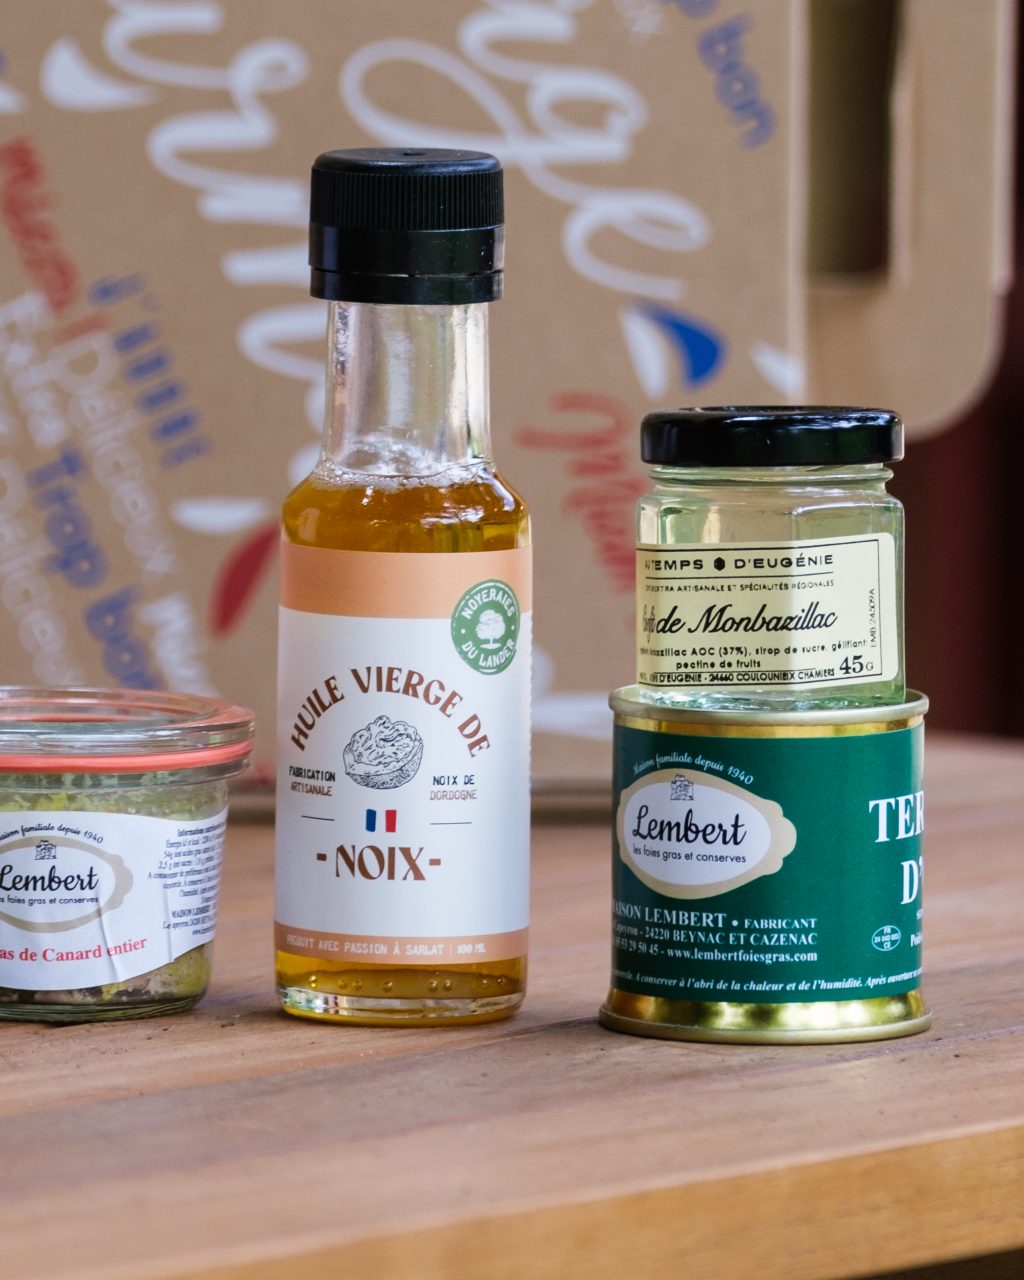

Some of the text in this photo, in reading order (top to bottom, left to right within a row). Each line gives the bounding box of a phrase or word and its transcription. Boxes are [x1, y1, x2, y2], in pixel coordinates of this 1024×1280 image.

[696, 12, 780, 152] bon
[734, 553, 834, 570] D'EUGÉNIE
[677, 585, 724, 593] ARTISANALE
[740, 582, 789, 591] SPÉCIALITÉS
[462, 587, 516, 620] NOYERAIES
[656, 605, 686, 634] de
[688, 601, 838, 634] Monbazillac
[461, 637, 516, 668] DU LANDER
[691, 646, 716, 656] AOC
[755, 645, 780, 657] sirop
[784, 644, 798, 655] de
[676, 659, 761, 671] pectine de fruits
[797, 668, 835, 679] CHAMIERS
[839, 655, 864, 675] 45
[290, 665, 491, 758] HUILE VIERGE DE
[288, 764, 336, 782] FABRICATION
[656, 752, 692, 769] familiale
[695, 754, 724, 772] depuis
[727, 765, 754, 785] 1940
[290, 781, 332, 797] ARTISANALE
[432, 774, 476, 786] NOIX DE
[430, 788, 477, 801] DORDOGNE
[21, 822, 55, 836] familiale
[57, 823, 82, 836] depuis
[83, 830, 105, 844] 1940
[632, 804, 747, 846] Lembert
[633, 843, 747, 863] les foies gras et conserves
[7, 895, 26, 905] foies
[28, 897, 47, 907] gras
[49, 896, 57, 905] et
[59, 896, 99, 905] conserves
[645, 906, 727, 928] LEMBERT
[744, 918, 818, 930] FABRICANT
[645, 926, 670, 940] 24220
[672, 930, 725, 945] BEYNAC
[728, 933, 747, 945] ET
[750, 932, 818, 946] CAZENAC
[19, 947, 37, 962] de
[42, 946, 103, 962] Canard
[106, 937, 146, 957] entier
[318, 938, 340, 952] AVEC
[344, 940, 388, 956] PASSION
[393, 939, 402, 955] À
[406, 941, 444, 956] SARLAT
[638, 941, 647, 953] 50
[648, 944, 659, 956] 45
[667, 947, 818, 965] www.lembertfoiesgras.com
[679, 977, 685, 987] à
[686, 978, 714, 989] l'abri
[716, 980, 729, 990] de
[731, 980, 741, 991] la
[743, 980, 783, 991] chaleur
[786, 981, 796, 991] et
[798, 980, 810, 991] de
[864, 974, 887, 989] Après
